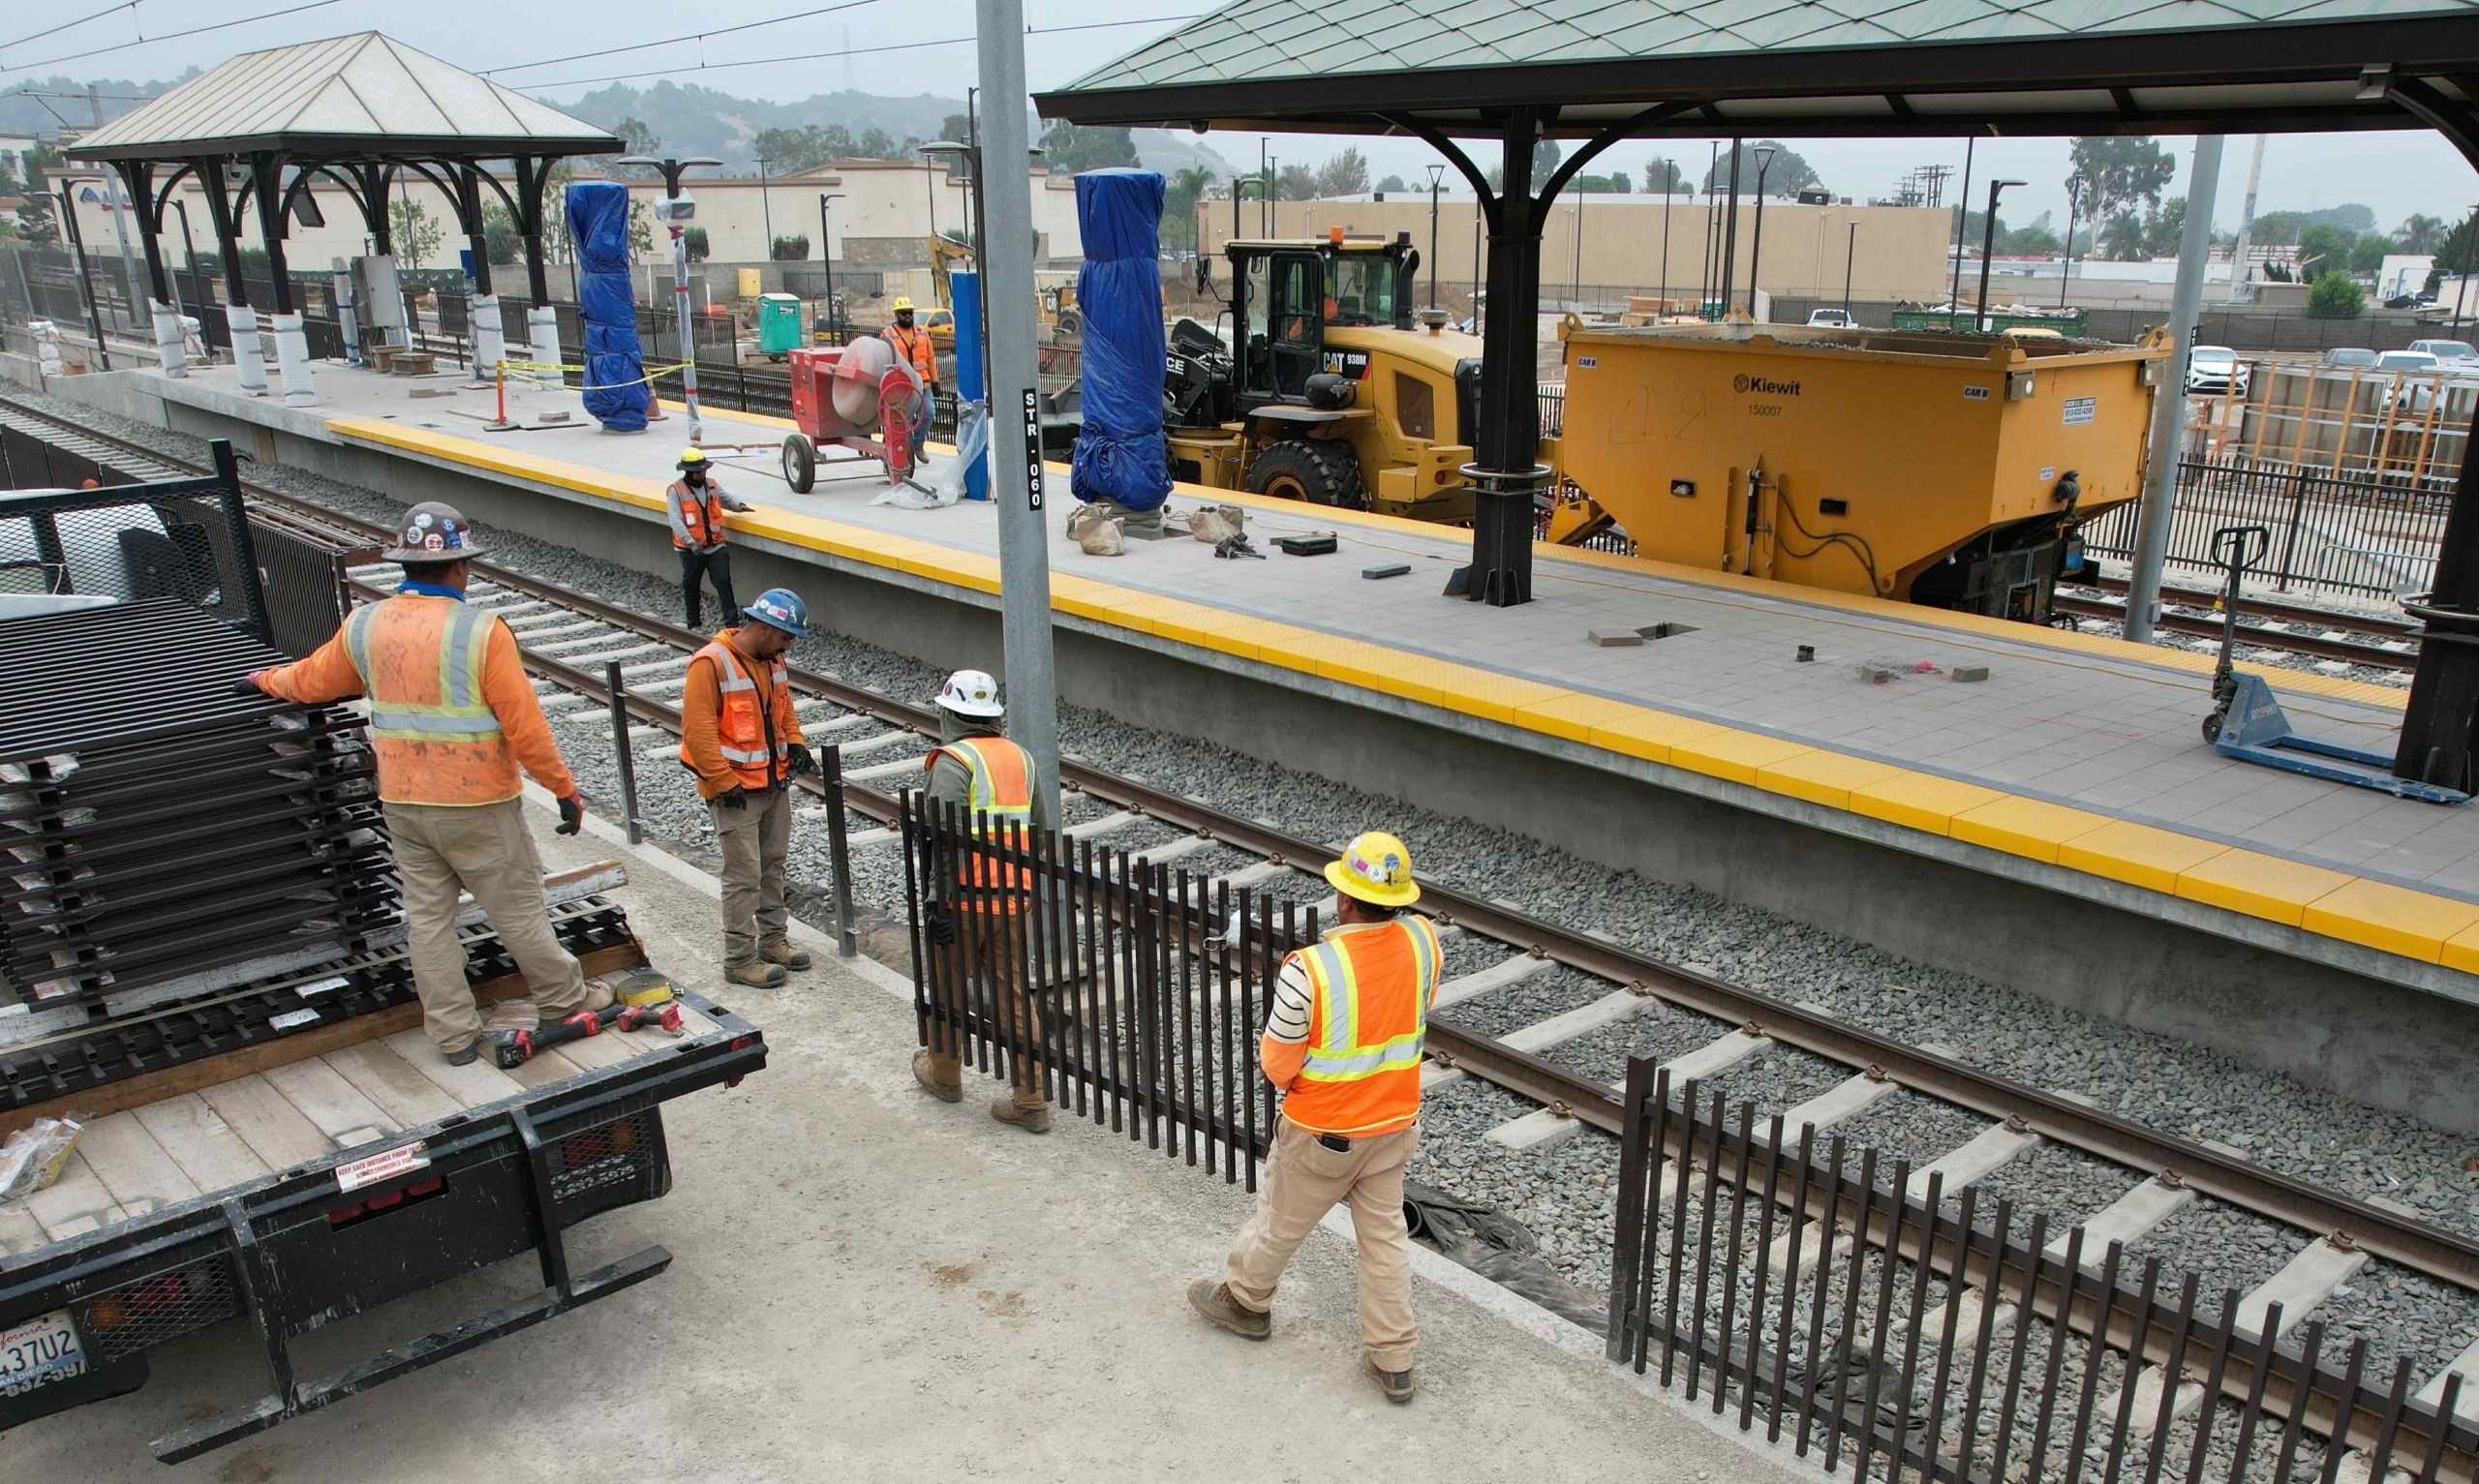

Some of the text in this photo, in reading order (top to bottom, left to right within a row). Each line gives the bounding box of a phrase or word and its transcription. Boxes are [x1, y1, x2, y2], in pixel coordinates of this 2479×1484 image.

[1323, 351, 1366, 374] CAT 938M
[1750, 377, 1801, 396] Kiewit
[1965, 387, 1989, 398] CAR B
[1748, 405, 1782, 416] 150007
[338, 1167, 352, 1176] KEEP
[352, 1163, 366, 1172] SAFE
[366, 1155, 391, 1166] DISTANCE
[392, 1150, 408, 1159] FROM
[17, 1363, 53, 1379] DIEGO
